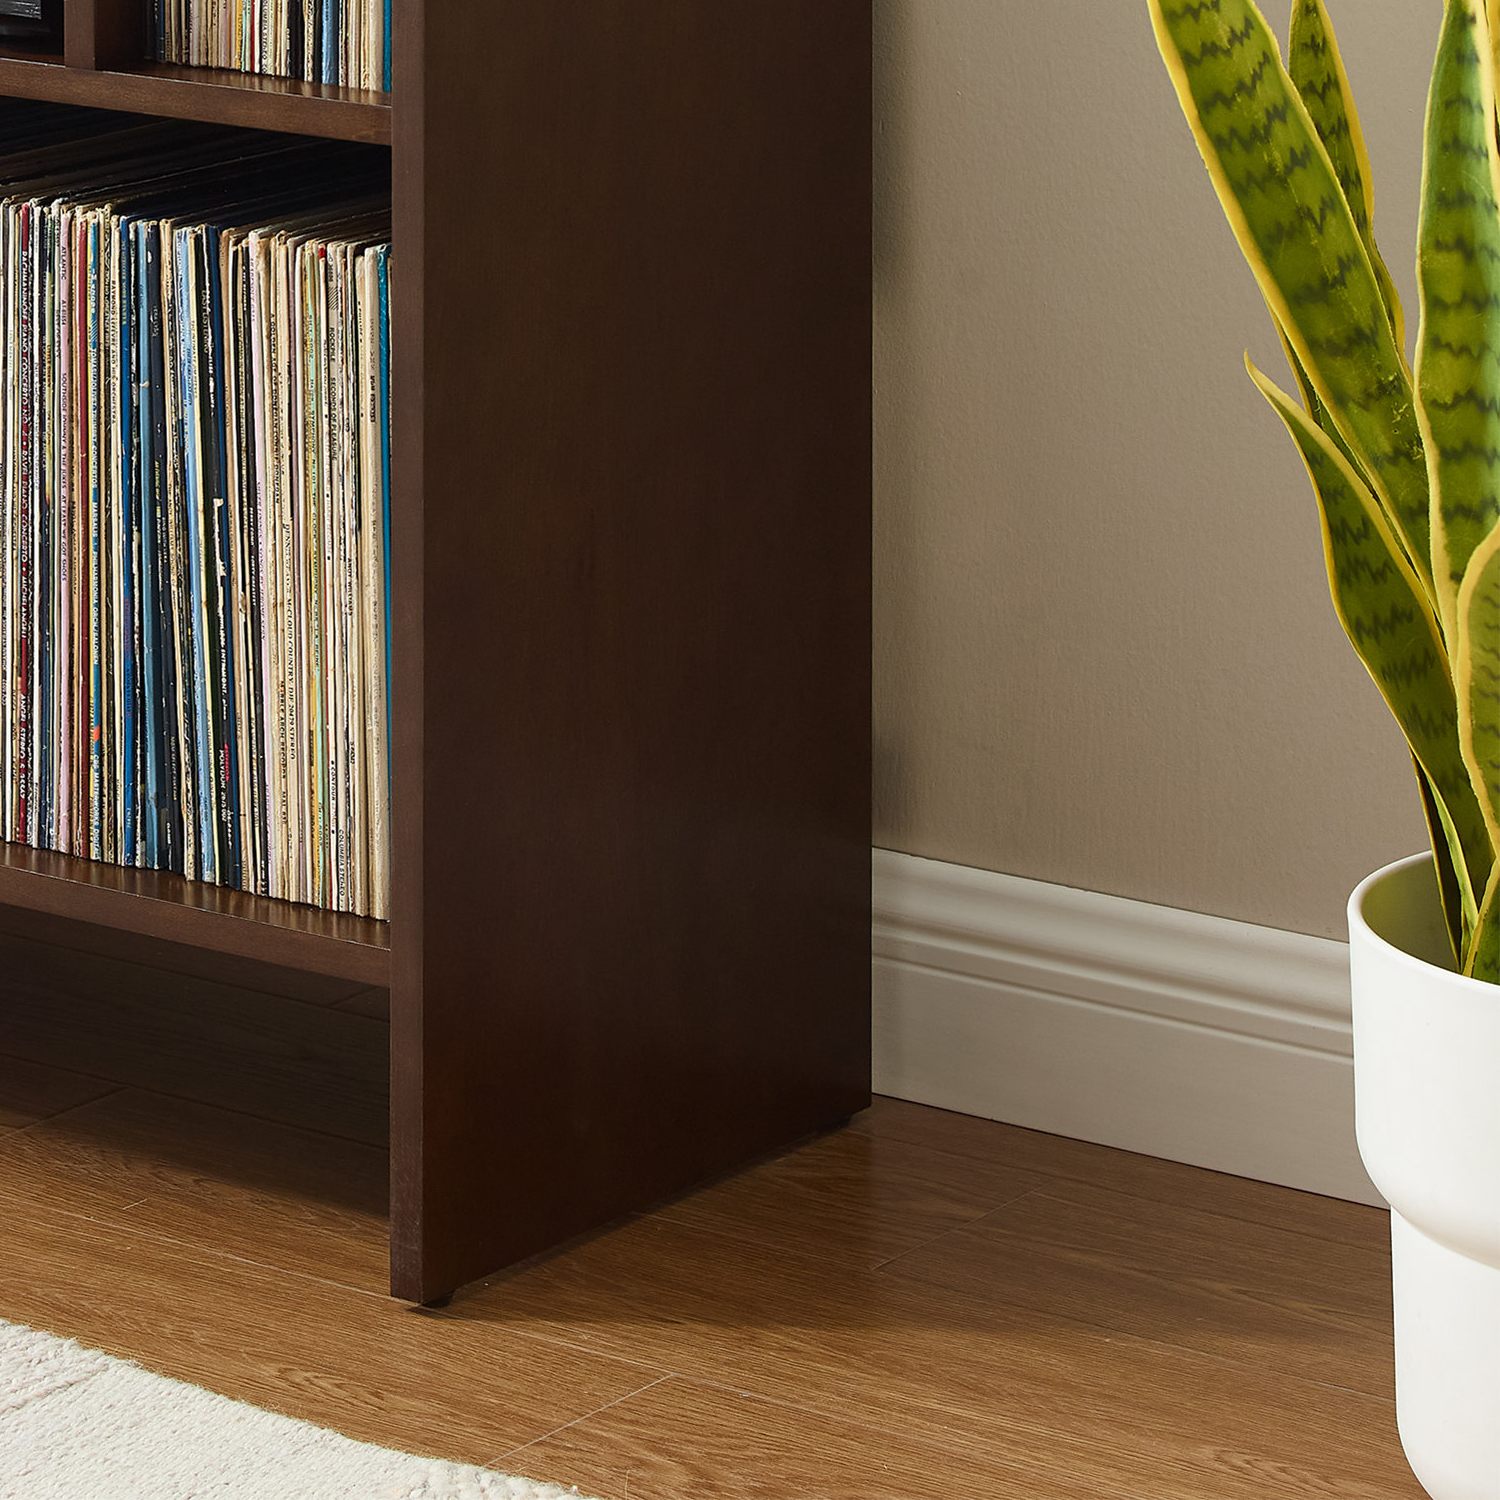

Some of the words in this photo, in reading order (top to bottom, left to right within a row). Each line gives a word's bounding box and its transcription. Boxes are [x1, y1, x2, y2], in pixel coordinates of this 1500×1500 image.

[201, 290, 209, 312] EASY
[271, 376, 278, 387] OF
[271, 389, 279, 429] DONEGAN
[330, 411, 337, 422] OF
[273, 464, 281, 504] DONEGAN
[61, 494, 67, 503] AT
[219, 749, 227, 789] POLYDOR
